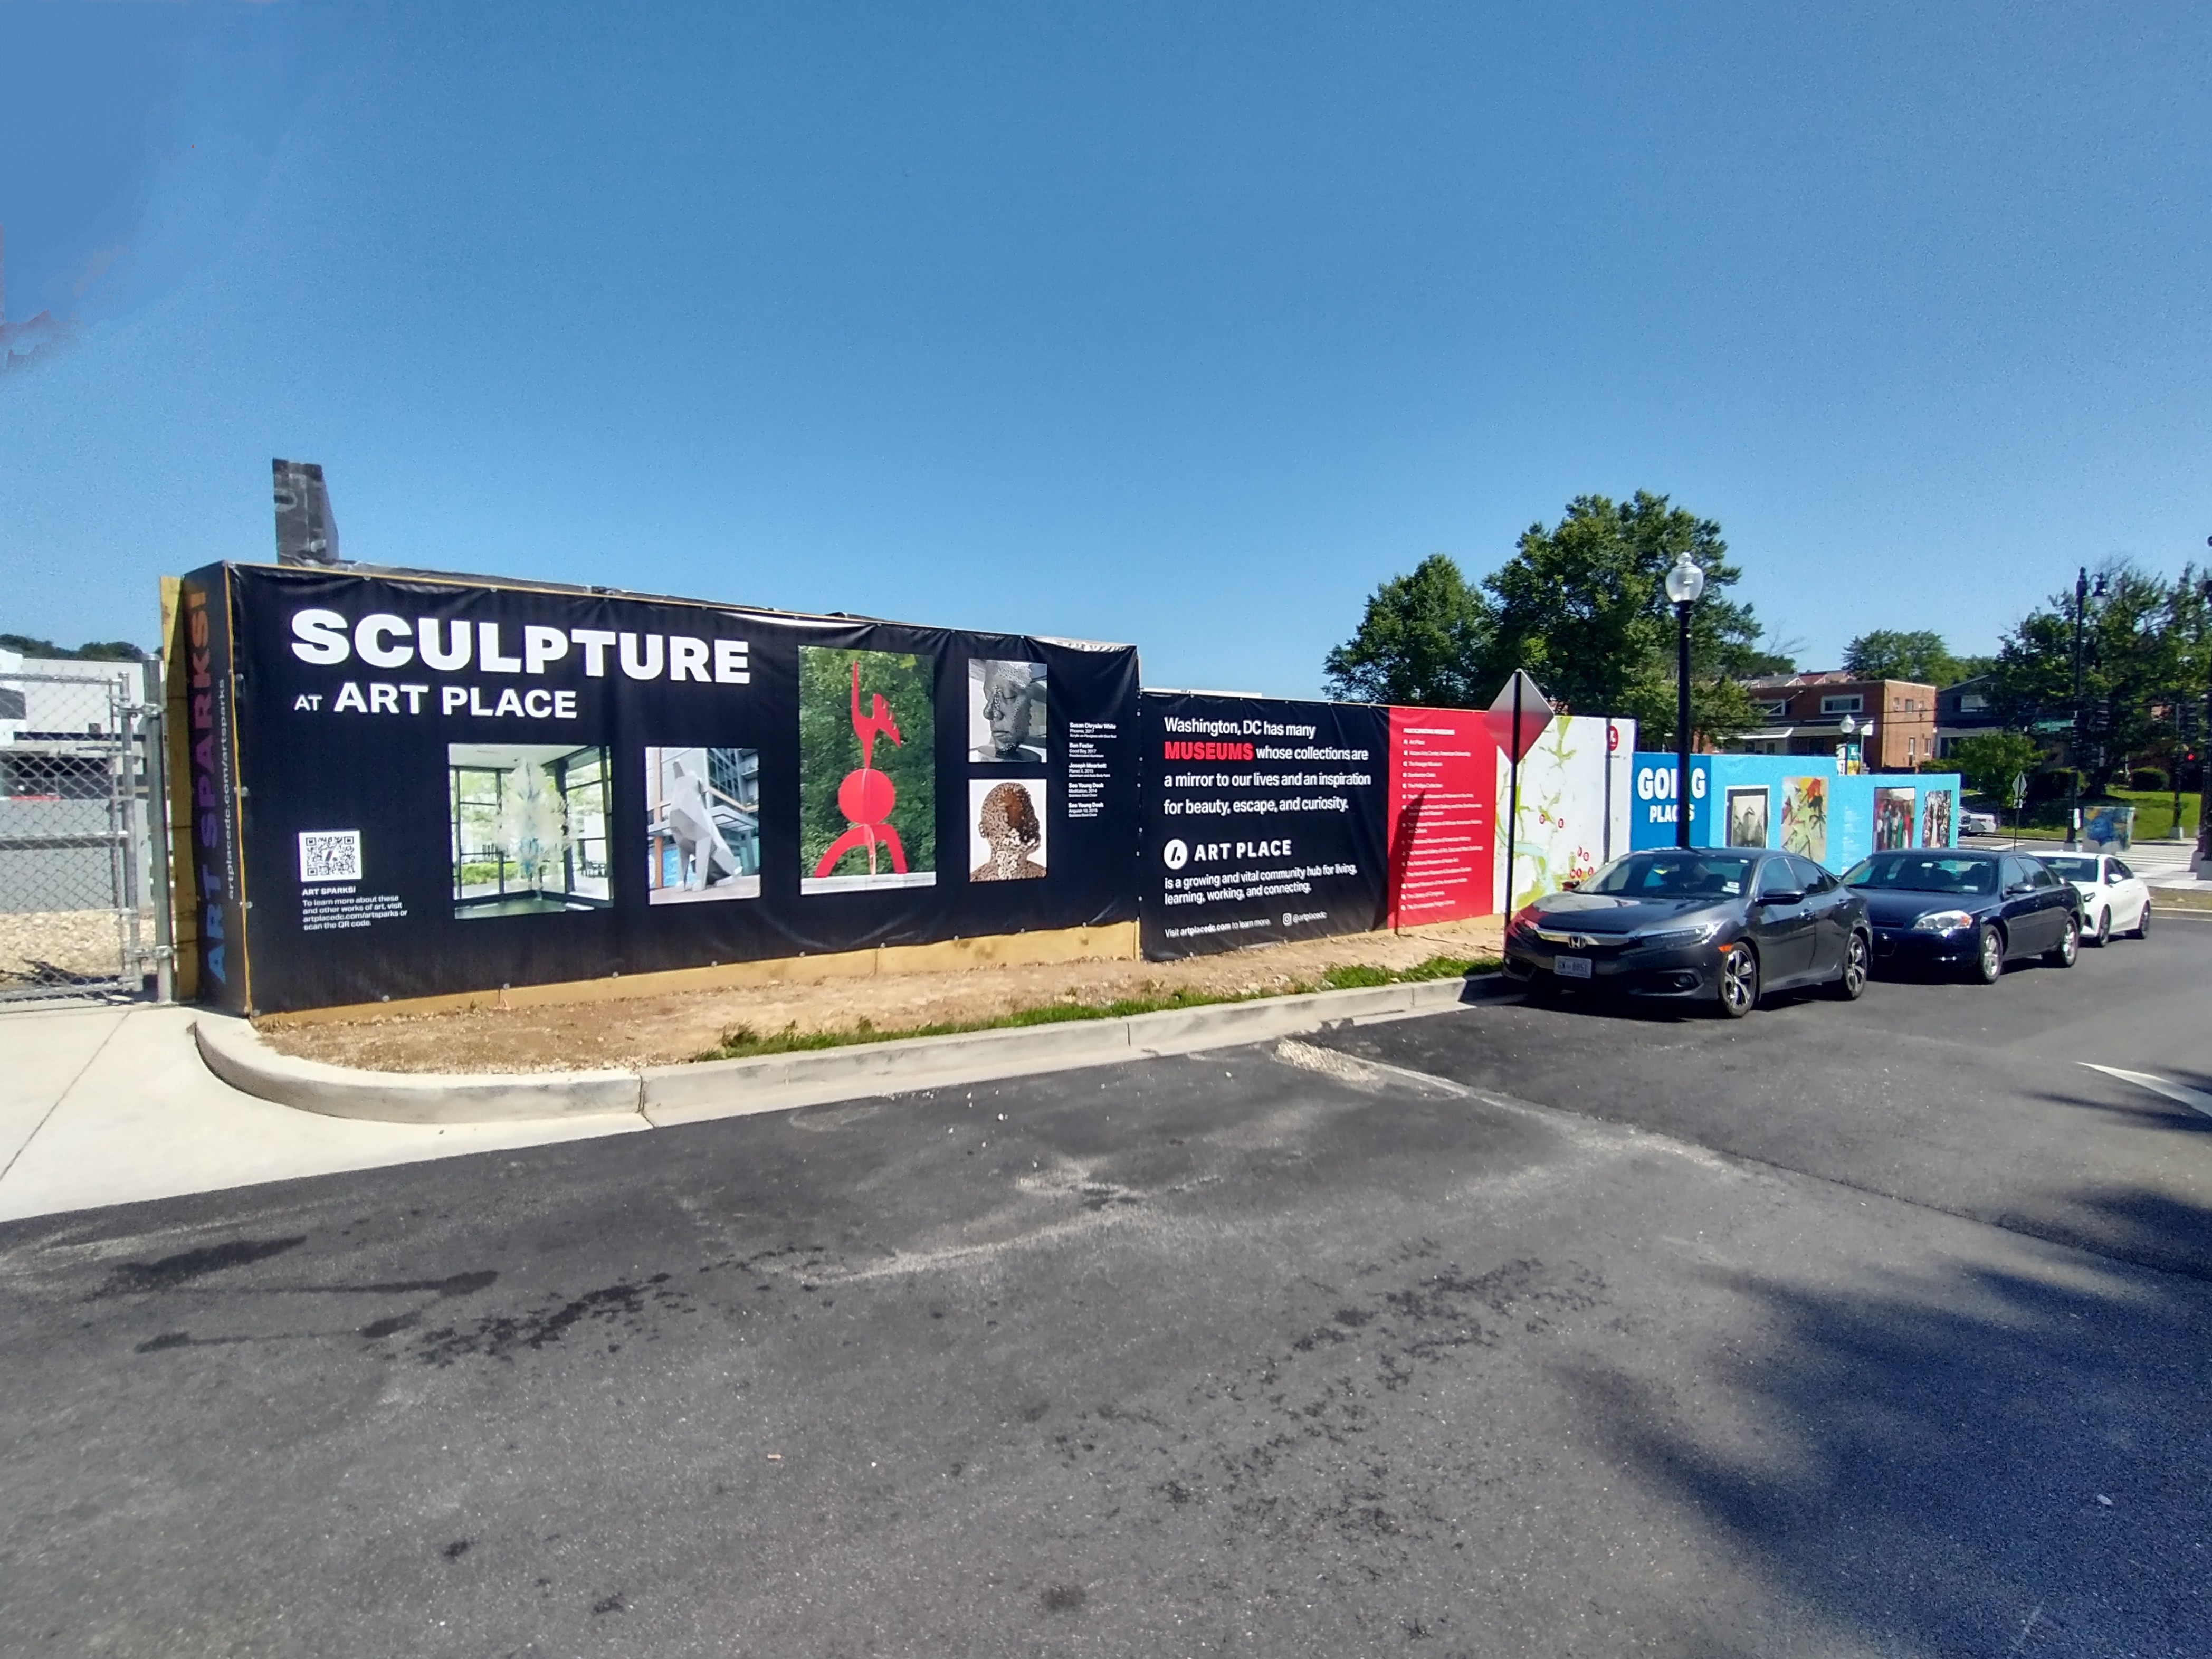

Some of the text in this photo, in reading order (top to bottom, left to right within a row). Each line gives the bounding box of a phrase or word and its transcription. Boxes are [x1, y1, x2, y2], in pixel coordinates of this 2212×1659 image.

[291, 608, 750, 684] SCULPTURE
[294, 682, 577, 719] AT ART PLACE
[1164, 717, 1316, 739] Washington, DC has many
[1165, 741, 1369, 760] MUSEUMS whose collections are
[190, 592, 226, 984] ART SPARKS!
[218, 679, 234, 900] artplacedc.com/artsparks
[1164, 772, 1371, 788] a mirror to our lives and an inspiration
[1637, 767, 1706, 800] GOIG
[1164, 796, 1349, 816] for beauty, escape, and curiosity.
[1649, 804, 1695, 823] PLACS
[1194, 840, 1292, 861] ART PLACE
[1165, 863, 1357, 890] is a growing and vital community hub for living,
[301, 886, 356, 896] ART SPARKS!
[1165, 881, 1312, 905] learning, working, and connecting.
[1165, 928, 1180, 938] Visit
[1239, 920, 1254, 928] learn
